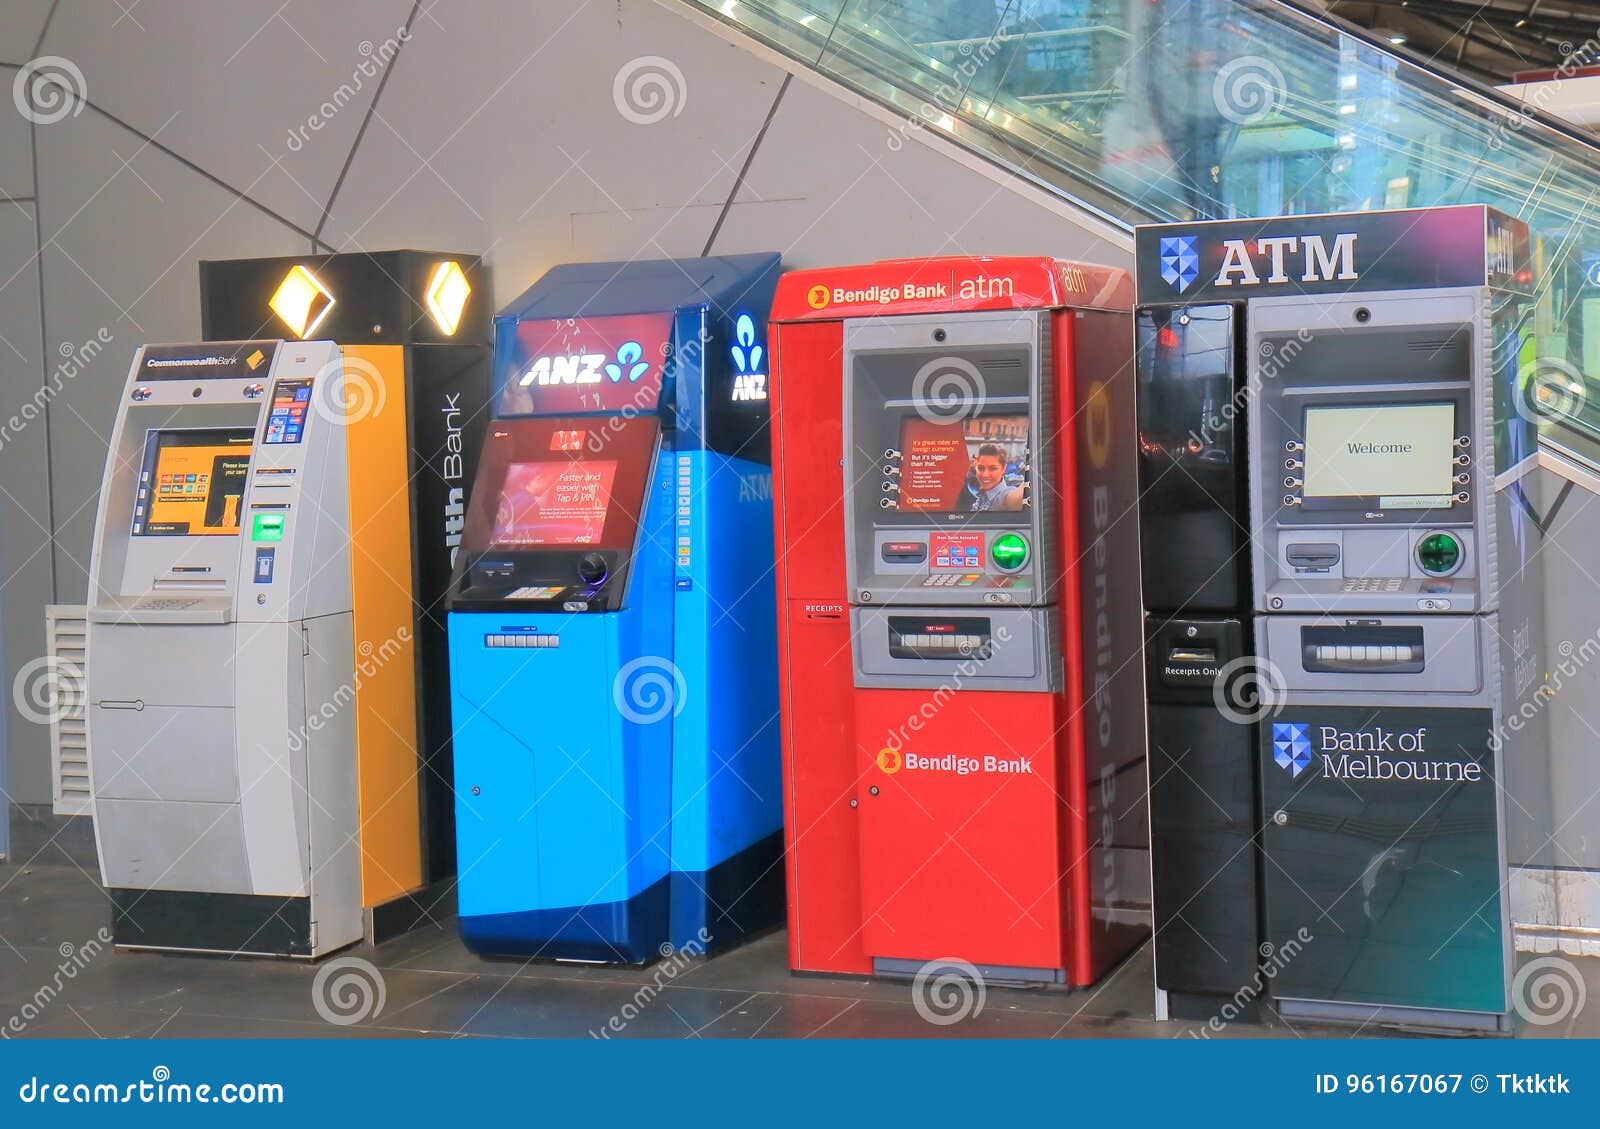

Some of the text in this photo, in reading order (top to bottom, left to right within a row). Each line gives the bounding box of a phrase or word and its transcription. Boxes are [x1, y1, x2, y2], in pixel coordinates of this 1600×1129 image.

[1214, 232, 1359, 286] ATM
[833, 274, 1014, 304] Bendigo Bank atm
[1062, 264, 1088, 293] atm
[147, 356, 238, 368] CommonwealthBank
[519, 354, 606, 386] ANZ
[731, 374, 767, 401] ANZ
[441, 392, 463, 480] Bank
[1347, 442, 1412, 454] Welcome
[559, 473, 601, 482] Faster and
[581, 483, 600, 492] with
[556, 493, 571, 504] Tap
[805, 604, 843, 612] RECEIPTS
[1165, 667, 1223, 677] Receipts Only
[1319, 726, 1427, 753] Bank of
[904, 753, 1033, 775] Bendigo Bank
[1321, 754, 1481, 782] Melbourne
